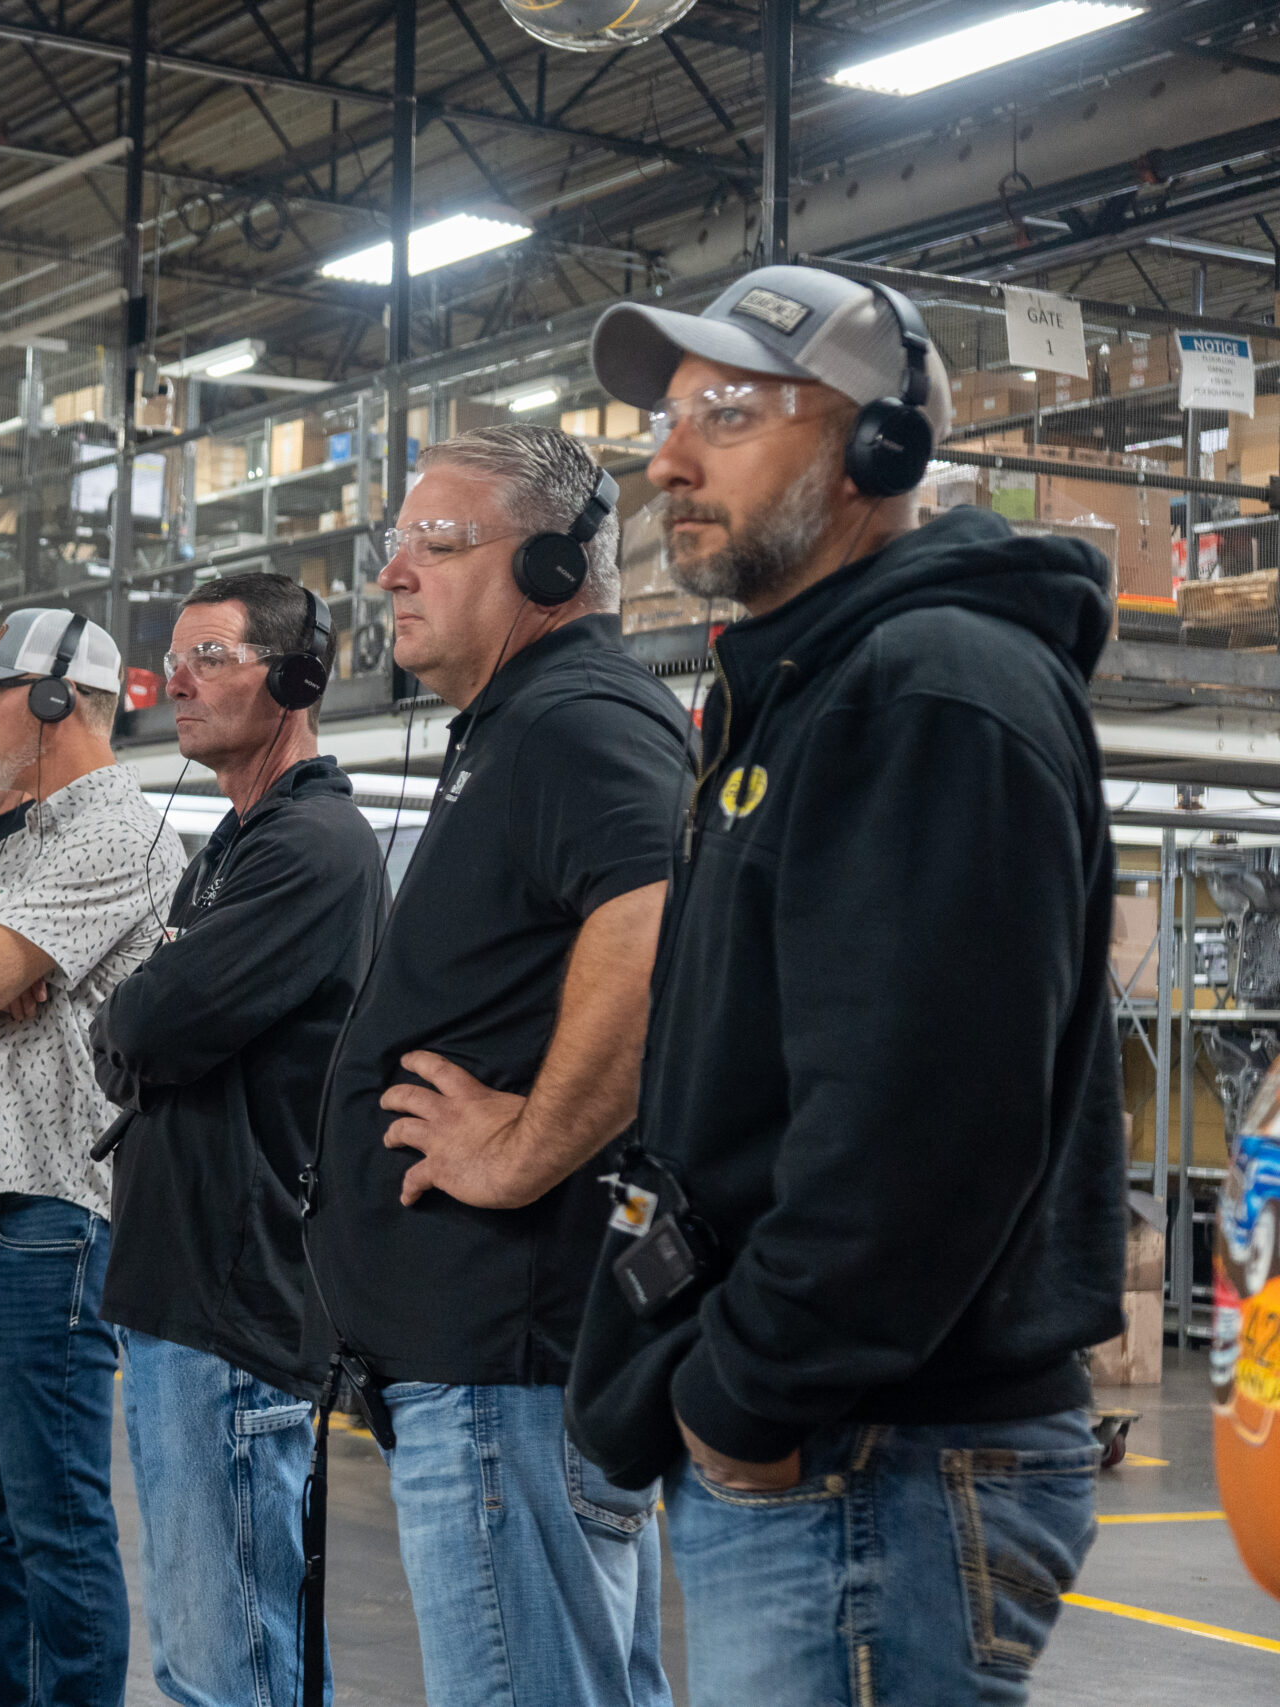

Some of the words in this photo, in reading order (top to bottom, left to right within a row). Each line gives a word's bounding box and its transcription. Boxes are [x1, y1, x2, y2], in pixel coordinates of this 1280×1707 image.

[1027, 306, 1065, 330] GATE
[1046, 338, 1055, 357] 1
[1193, 338, 1239, 357] NOTICE
[556, 565, 577, 582] SONY
[304, 678, 321, 690] SONY
